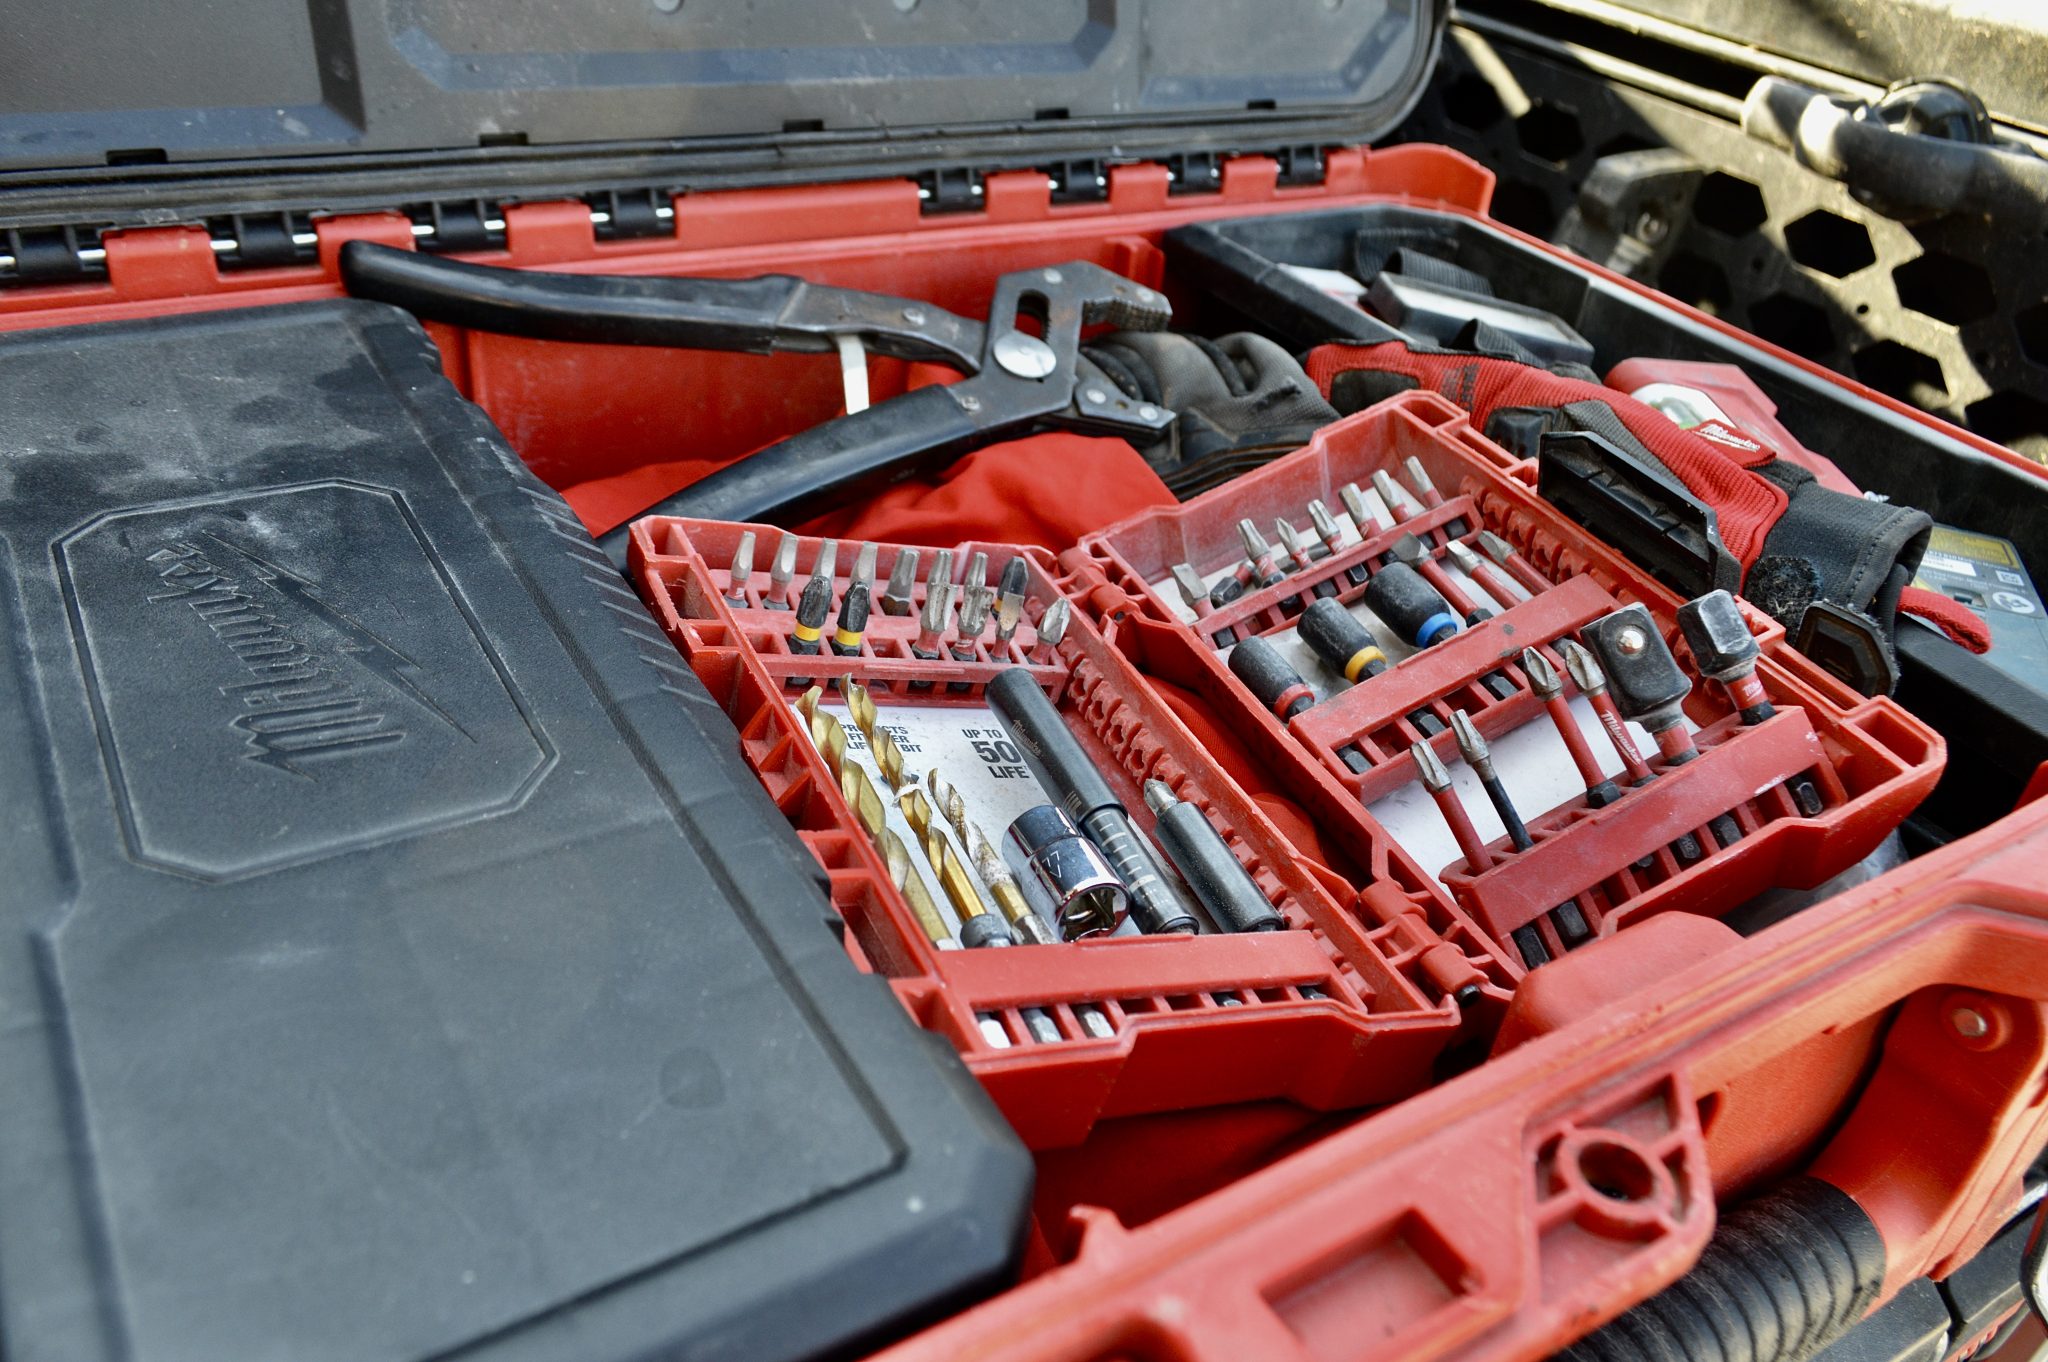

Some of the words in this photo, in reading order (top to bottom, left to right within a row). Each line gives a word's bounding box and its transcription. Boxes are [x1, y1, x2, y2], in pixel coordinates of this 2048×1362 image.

[962, 729, 980, 739] UP
[983, 729, 1003, 739] TO
[1601, 710, 1642, 765] Milwaukee
[900, 744, 922, 753] BIT
